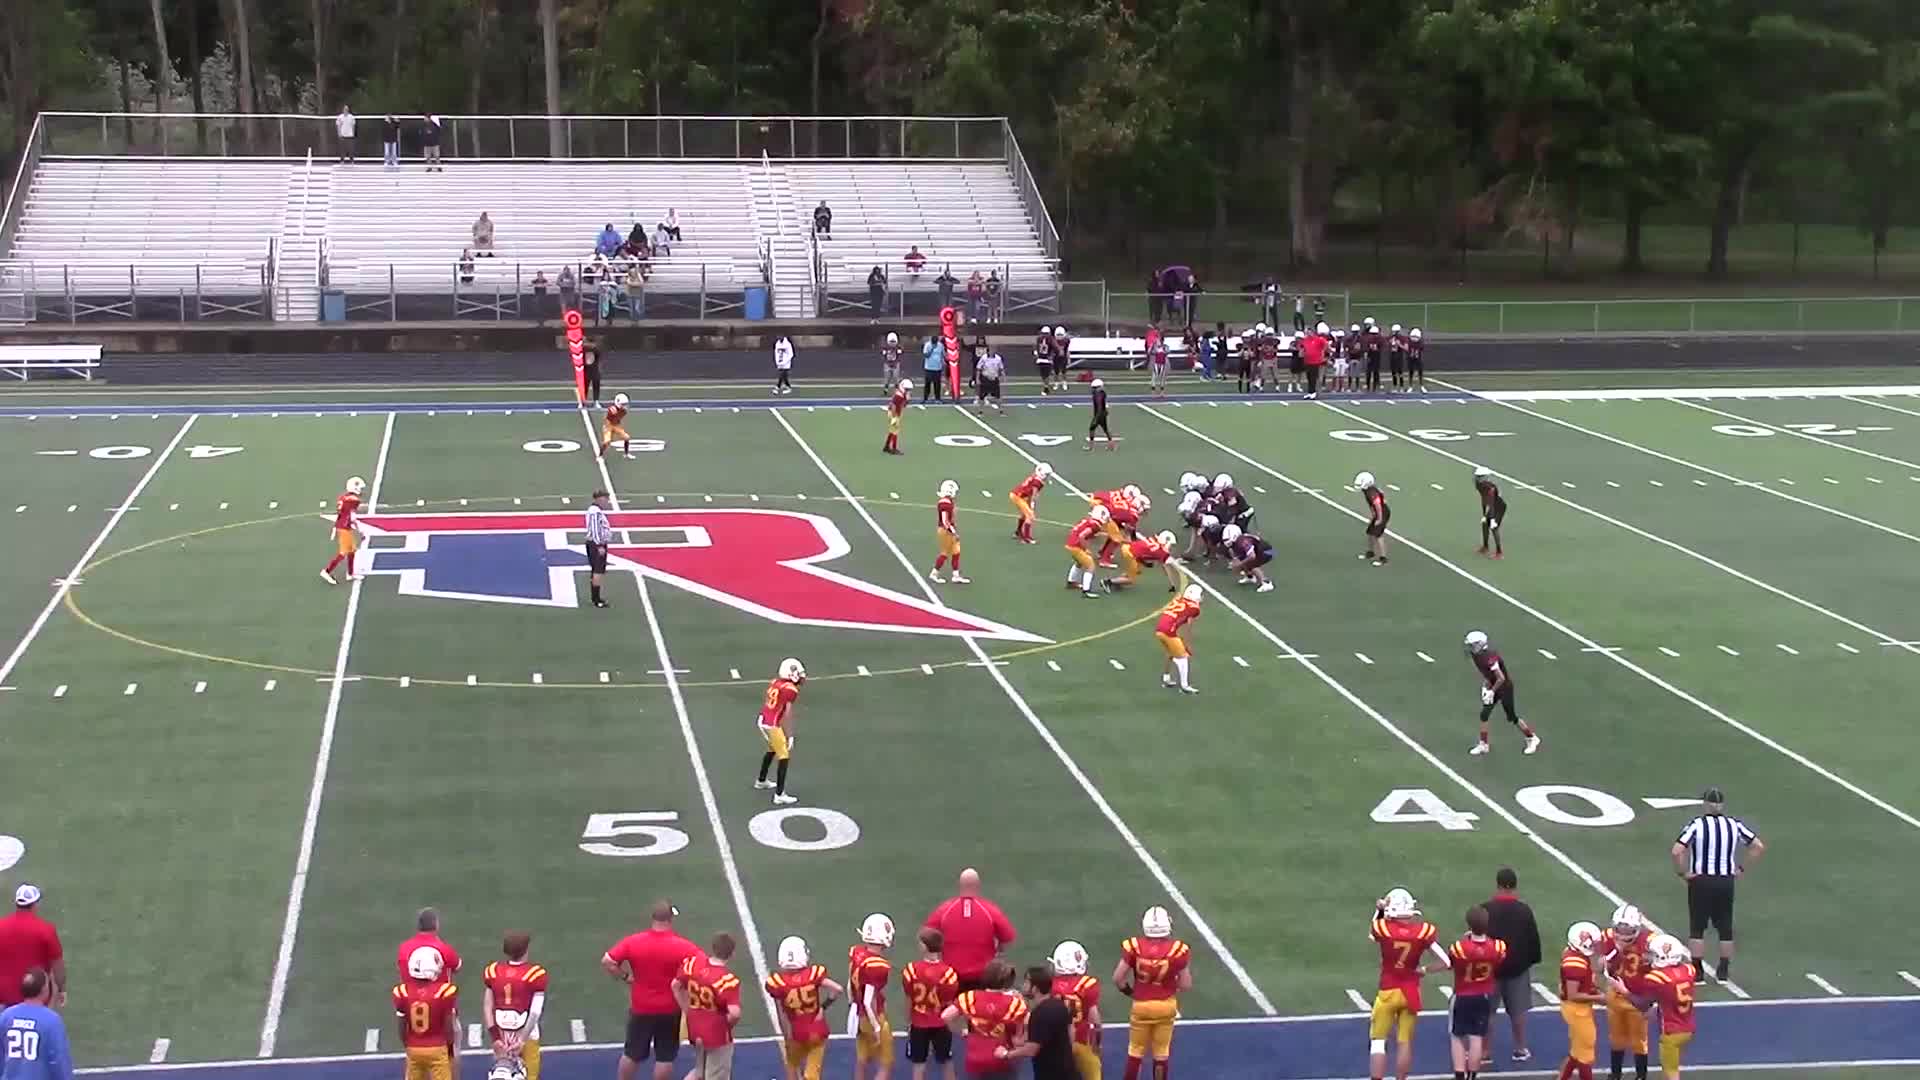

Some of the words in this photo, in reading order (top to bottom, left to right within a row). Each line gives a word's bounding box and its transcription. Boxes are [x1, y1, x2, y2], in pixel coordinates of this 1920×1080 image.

[1369, 784, 1636, 831] 40
[577, 806, 861, 857] 50
[1392, 941, 1412, 969] 7
[1135, 956, 1170, 986] 57
[1463, 961, 1492, 983] 13
[503, 983, 512, 1006] 1
[784, 984, 818, 1015] 45
[1675, 981, 1694, 1014] 5
[409, 1001, 431, 1034] 8
[7, 1029, 40, 1061] 20
